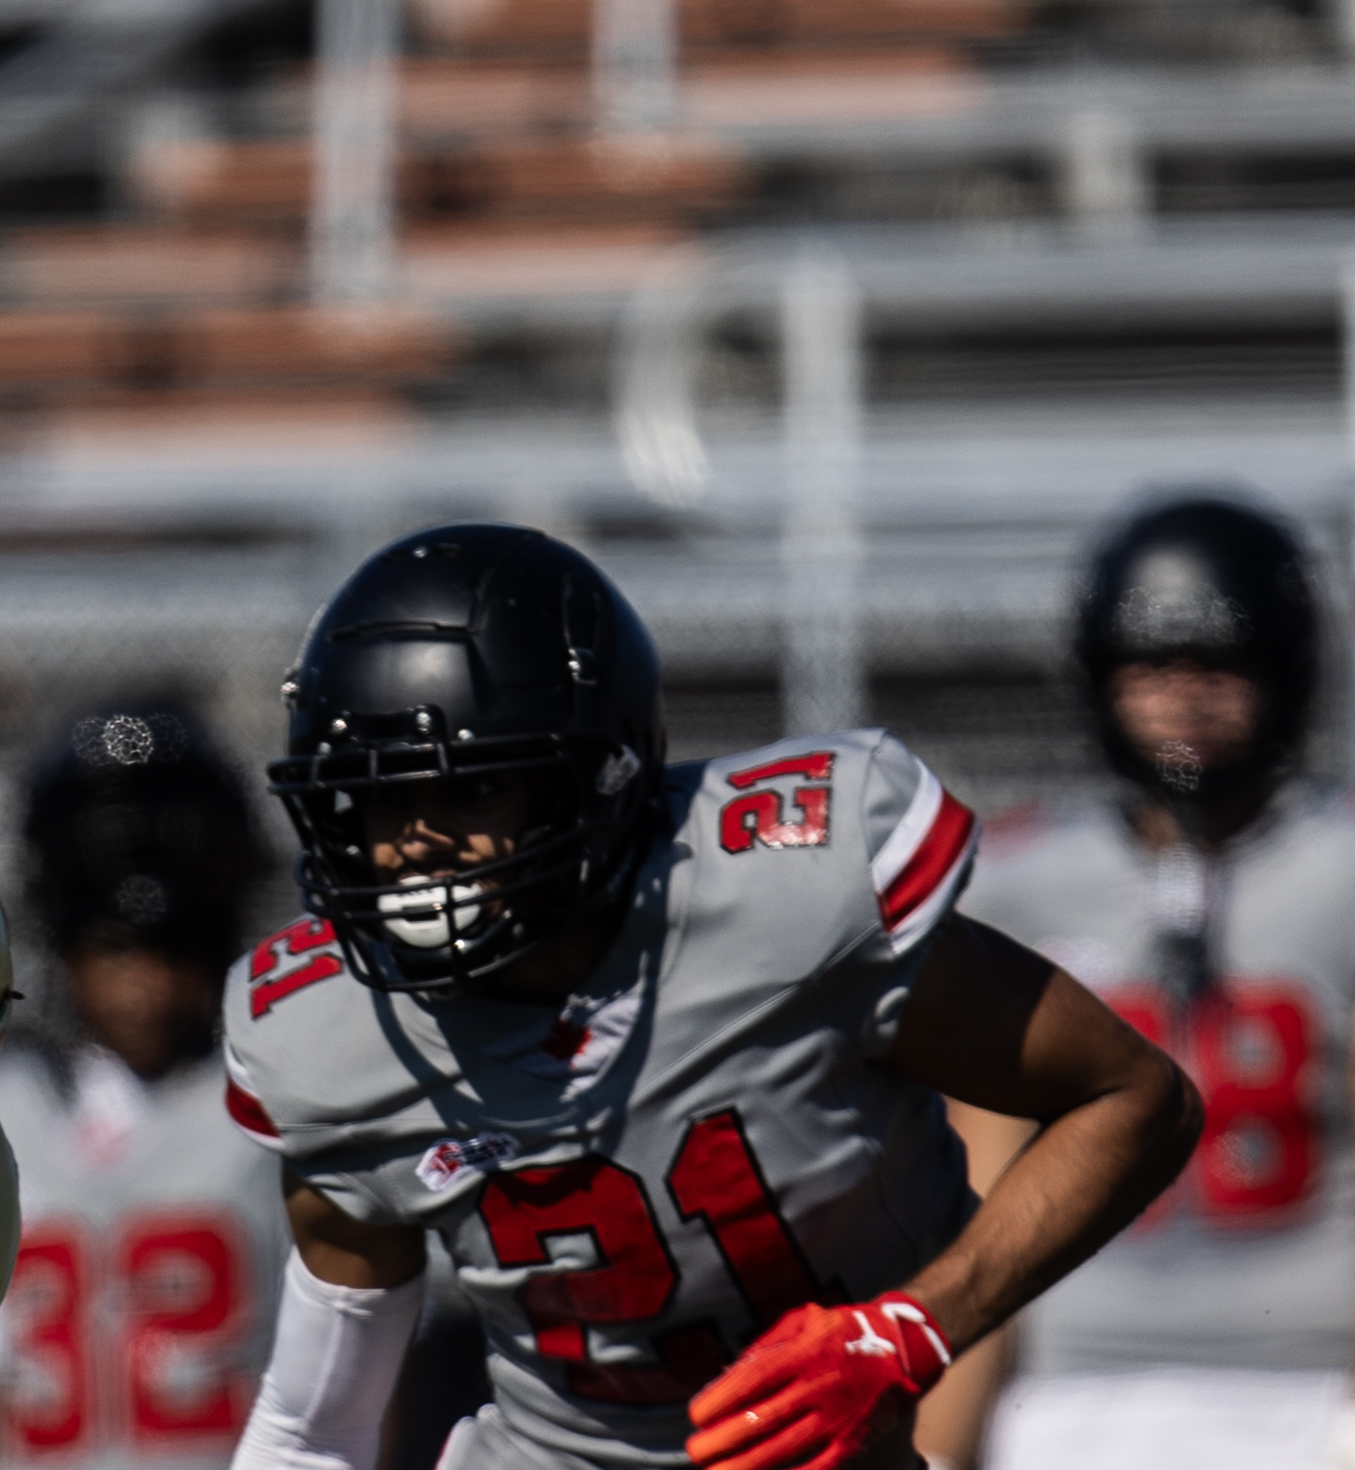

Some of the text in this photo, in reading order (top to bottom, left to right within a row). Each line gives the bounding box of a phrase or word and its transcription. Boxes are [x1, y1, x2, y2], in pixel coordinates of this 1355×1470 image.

[720, 750, 838, 855] 21
[249, 917, 345, 1021] 21
[6, 1220, 256, 1450] 32
[477, 1106, 853, 1404] 21
